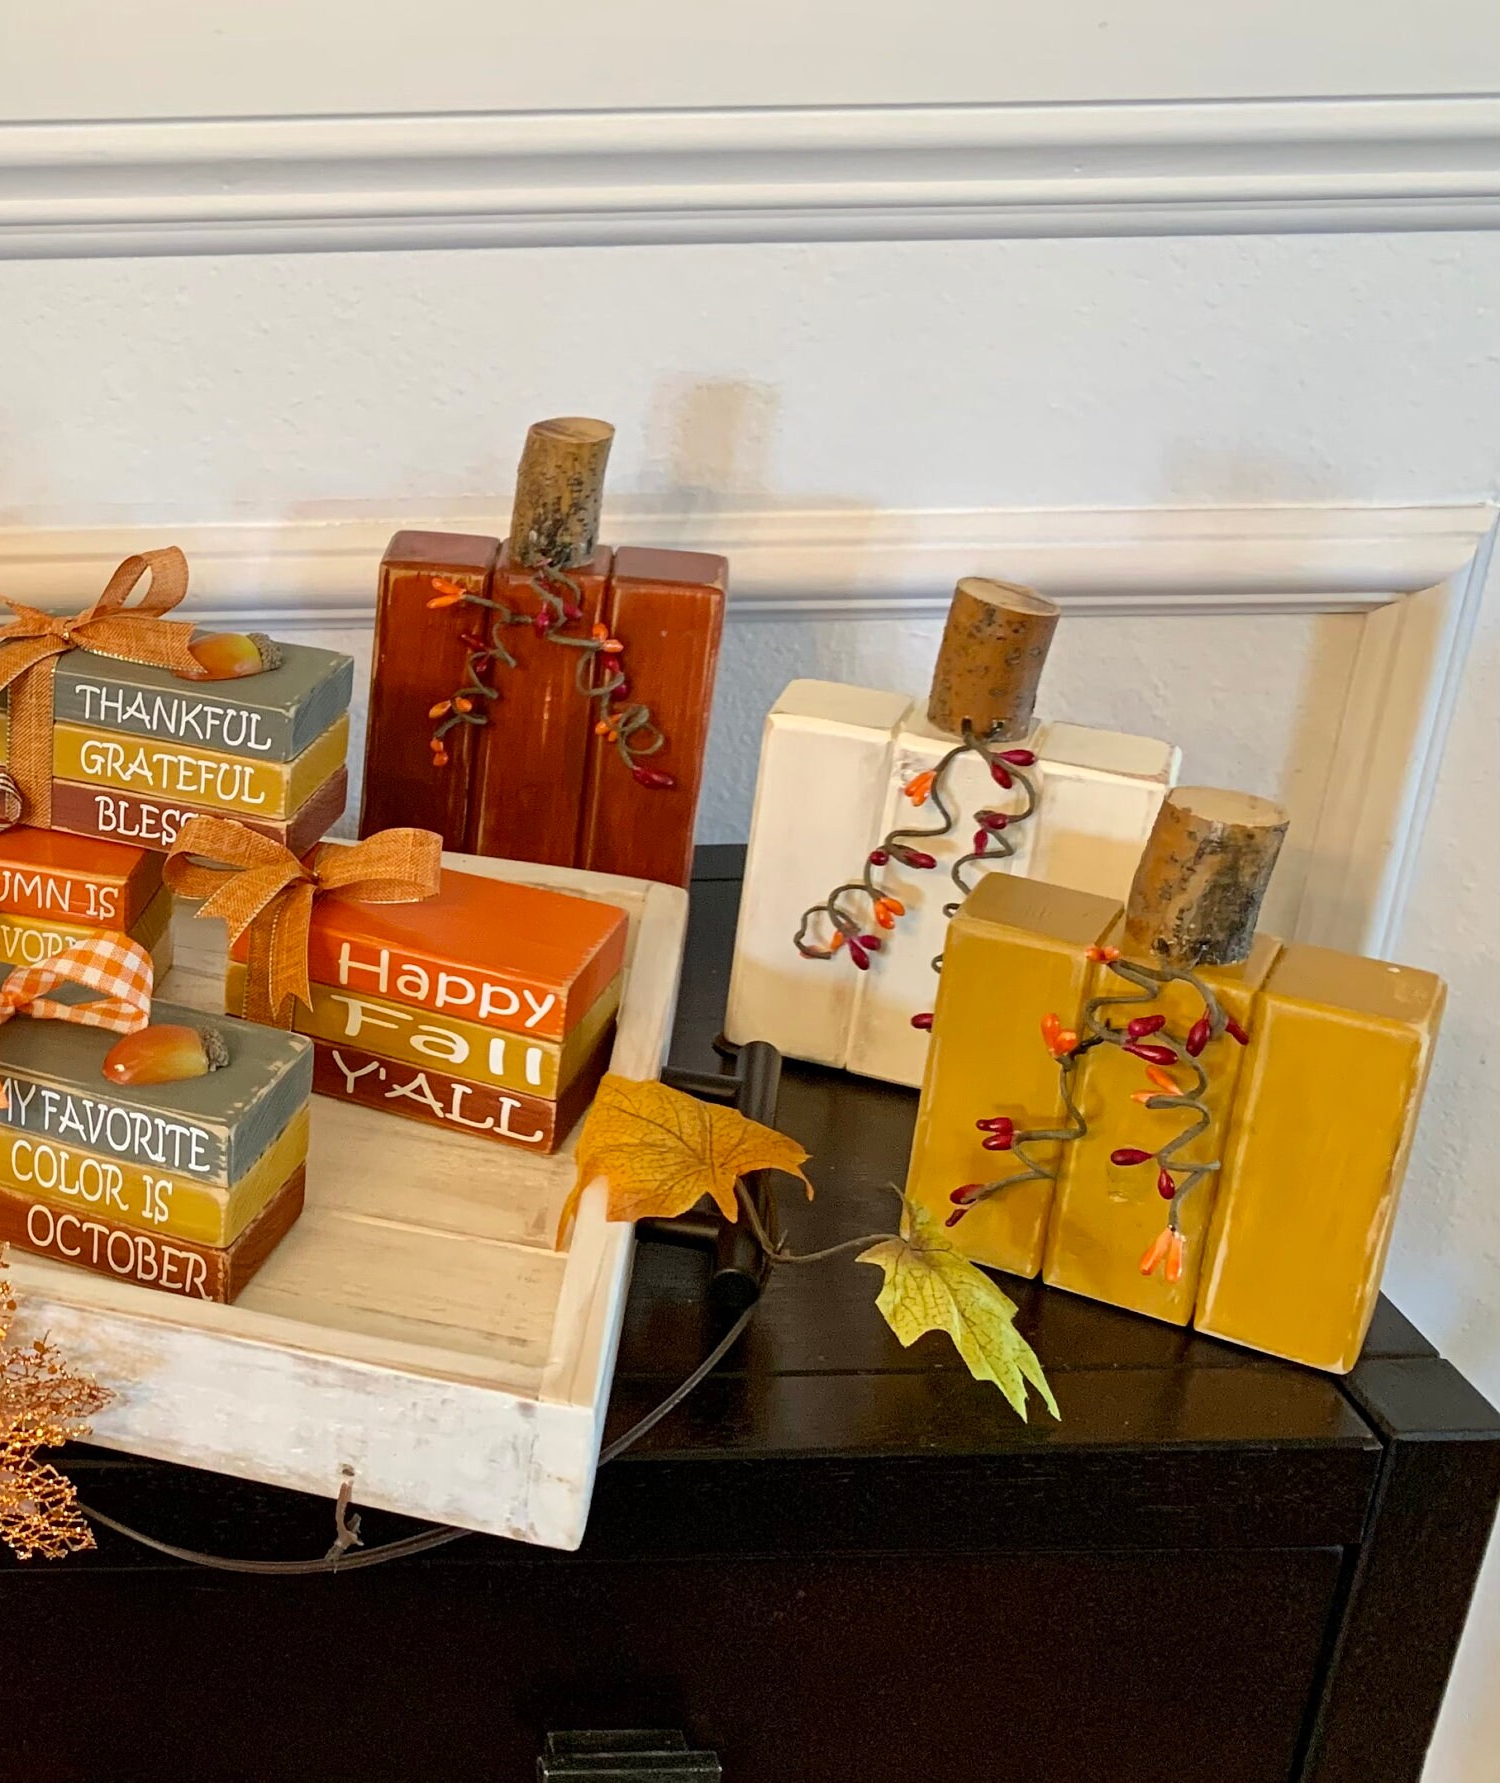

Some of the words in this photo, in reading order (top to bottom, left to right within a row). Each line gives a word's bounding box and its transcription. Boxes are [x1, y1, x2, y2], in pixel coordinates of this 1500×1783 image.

[75, 684, 272, 750] THANKFUL
[80, 740, 265, 804] GRATEFUL
[94, 795, 198, 846] BLES
[85, 883, 119, 920] IS
[338, 941, 556, 1029] Happy
[330, 993, 543, 1086] Fall
[41, 1089, 211, 1173] FAVORITE
[331, 1049, 544, 1144] Y'ALL
[11, 1139, 129, 1211] COLOR
[141, 1174, 174, 1225] IS
[26, 1203, 214, 1301] OCTOBER
